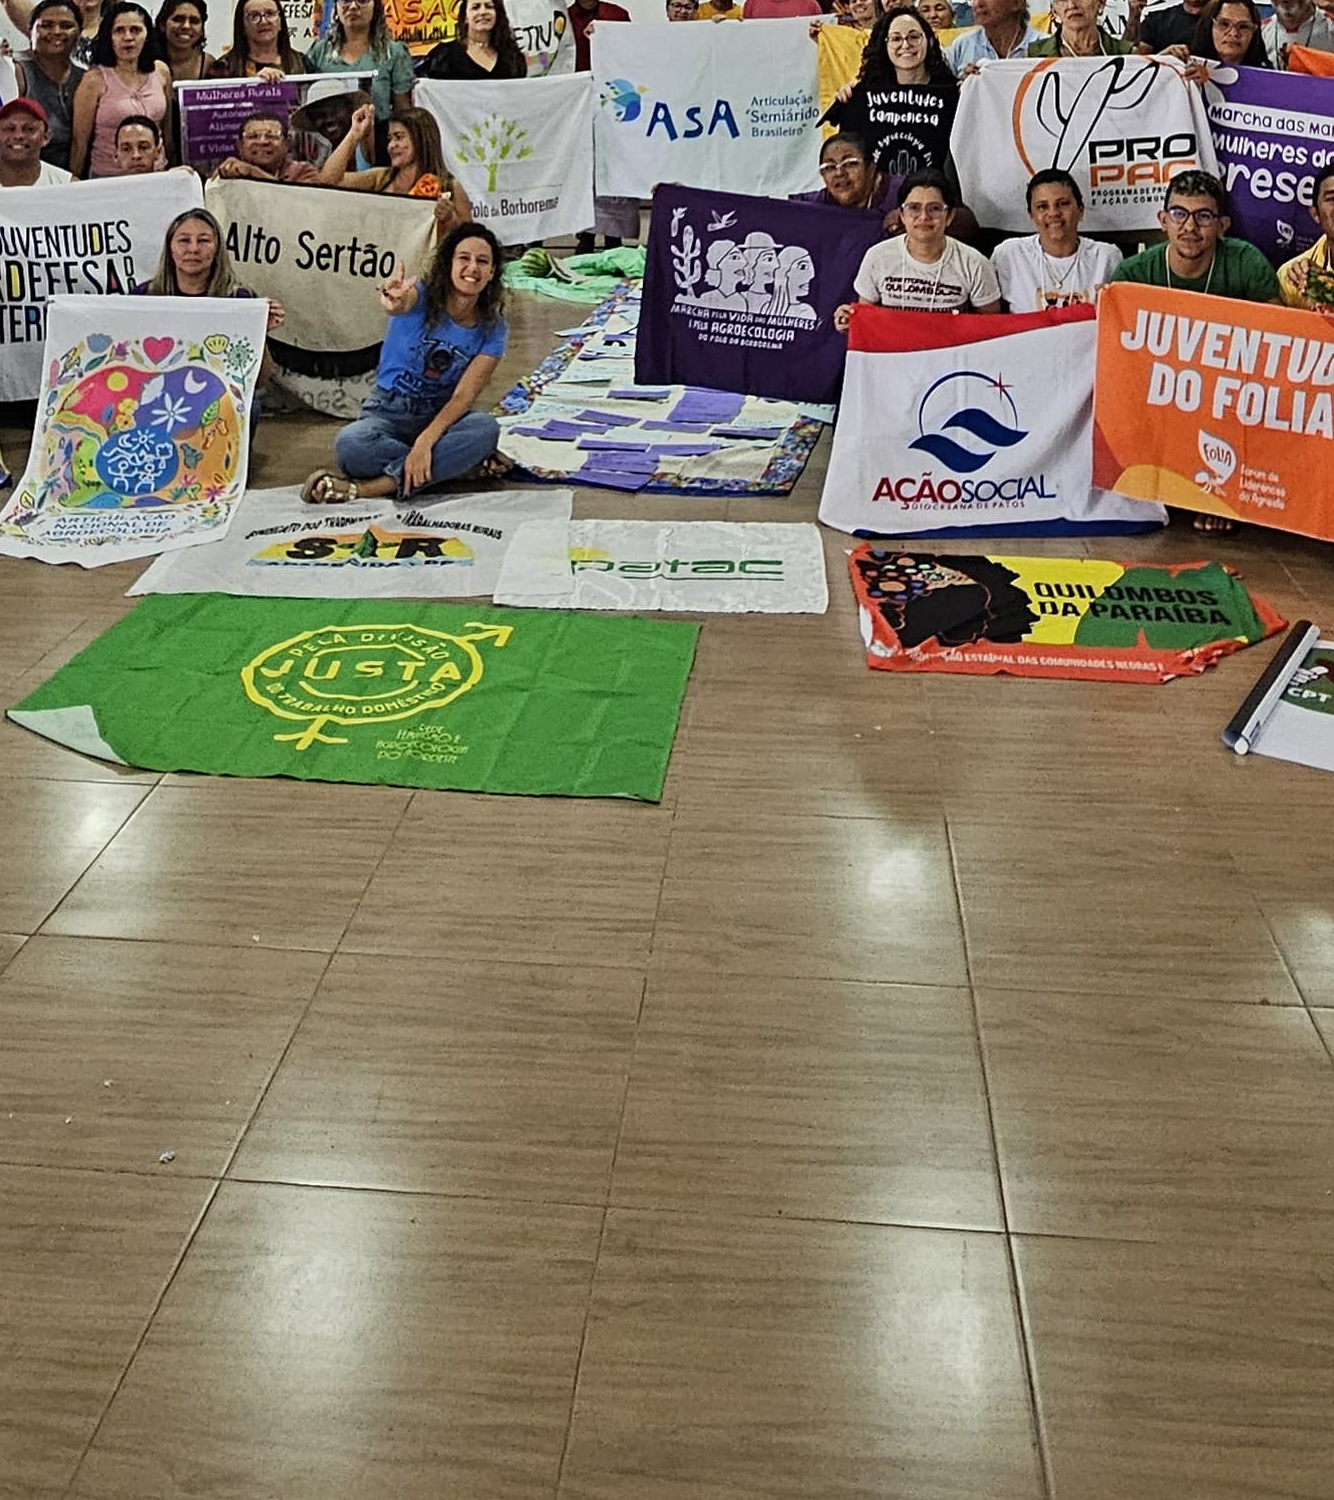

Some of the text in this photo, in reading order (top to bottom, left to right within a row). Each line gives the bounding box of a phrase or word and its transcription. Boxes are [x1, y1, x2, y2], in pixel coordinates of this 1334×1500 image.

[196, 86, 282, 101] Mulheres Rurais
[750, 89, 814, 106] Articulação
[867, 89, 944, 109] Juventudes
[646, 99, 740, 141] ASA
[750, 106, 820, 124] Semiárido
[1210, 106, 1272, 128] Marcha
[1276, 117, 1305, 133] das
[751, 126, 803, 138] Brasileiro
[1088, 133, 1197, 165] PRO
[1212, 131, 1308, 166] Mulheres
[1091, 186, 1138, 198] PROGRAMA
[501, 196, 560, 216] Borborema
[226, 222, 395, 279] Alto Sertão
[7, 257, 127, 303] DEFESA
[670, 303, 710, 319] MARCHA
[729, 311, 754, 324] VIDA
[767, 315, 816, 331] MULHERES
[693, 319, 709, 331] PELA
[711, 321, 795, 343] AGROECOLOGIA
[1147, 362, 1334, 439] DO FOLIA
[975, 500, 989, 510] DE
[992, 499, 1027, 510] PATOS
[40, 526, 172, 537] AGROECOLOGIA
[53, 519, 168, 531] NACIONAL DE
[570, 558, 784, 576] patac
[1034, 582, 1218, 606] QUILOMBOS
[1038, 600, 1233, 626] DA PARAÍBA
[288, 631, 348, 657] PELA
[260, 657, 463, 683] JUSTA
[1017, 656, 1039, 666] DAS
[279, 692, 356, 714] TRABALHO
[1288, 687, 1330, 704] CPT
